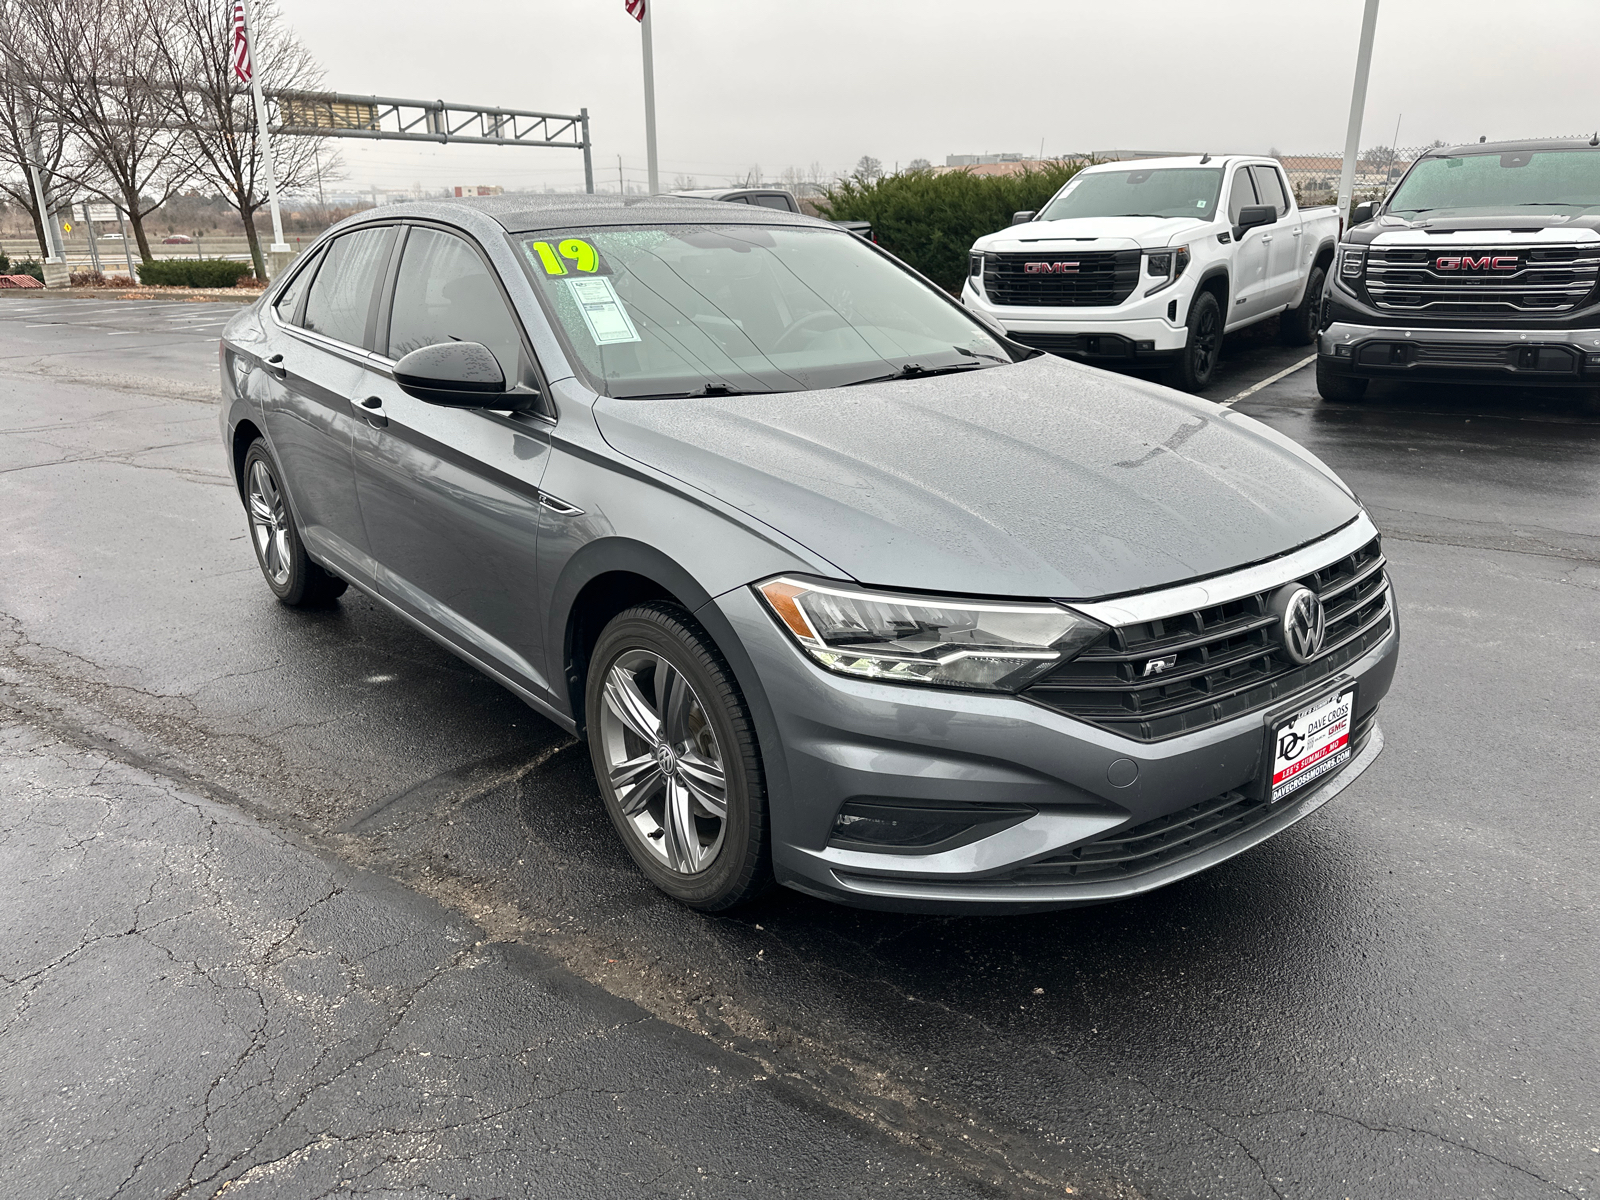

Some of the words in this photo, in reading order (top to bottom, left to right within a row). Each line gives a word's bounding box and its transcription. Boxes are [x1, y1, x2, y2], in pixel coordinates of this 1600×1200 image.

[533, 239, 599, 275] 19
[1024, 262, 1080, 274] GMC
[1436, 256, 1519, 270] GMC
[1307, 715, 1327, 734] DAVE
[1327, 702, 1349, 722] CROSS
[1328, 719, 1347, 735] GMC
[1272, 749, 1351, 801] DAVECROSSMOTORS.COM
[1281, 763, 1300, 780] LEE'S
[1328, 740, 1340, 753] MO
